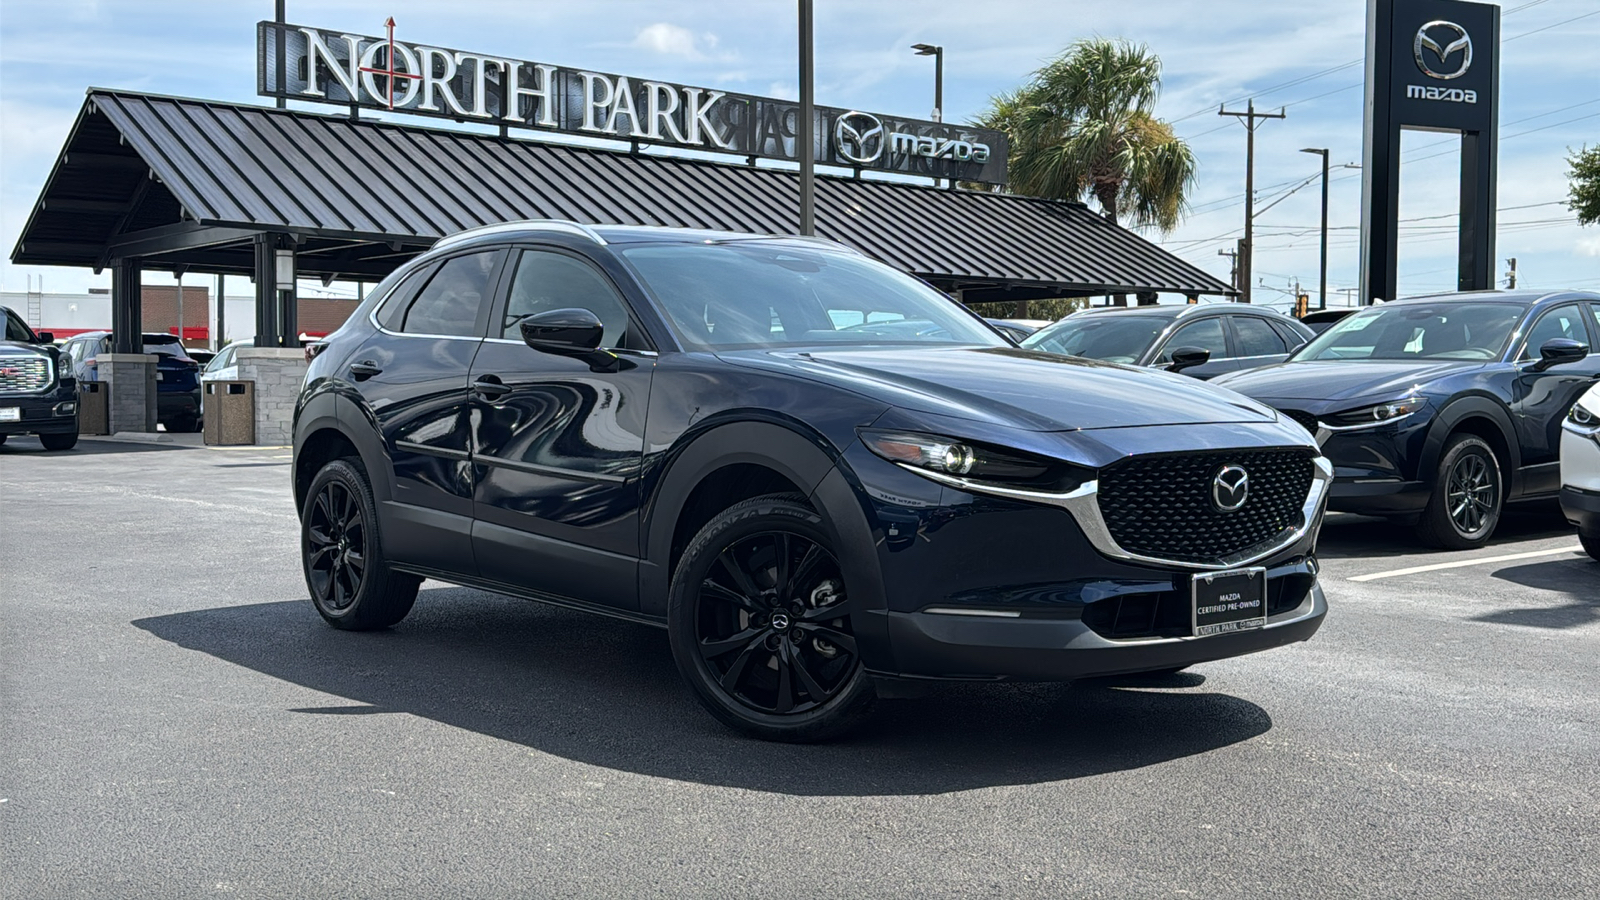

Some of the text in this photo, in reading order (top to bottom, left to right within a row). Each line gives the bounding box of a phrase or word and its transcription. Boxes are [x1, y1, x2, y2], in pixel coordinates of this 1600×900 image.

[299, 28, 558, 126] NORTH
[577, 71, 730, 149] PARK
[1406, 84, 1477, 104] mazda
[890, 131, 991, 165] mazda
[1219, 593, 1241, 602] MAZDA
[1197, 600, 1260, 615] CERTIFIED PRE-OWNED
[1200, 625, 1220, 635] NORTH
[1221, 623, 1238, 632] PARK
